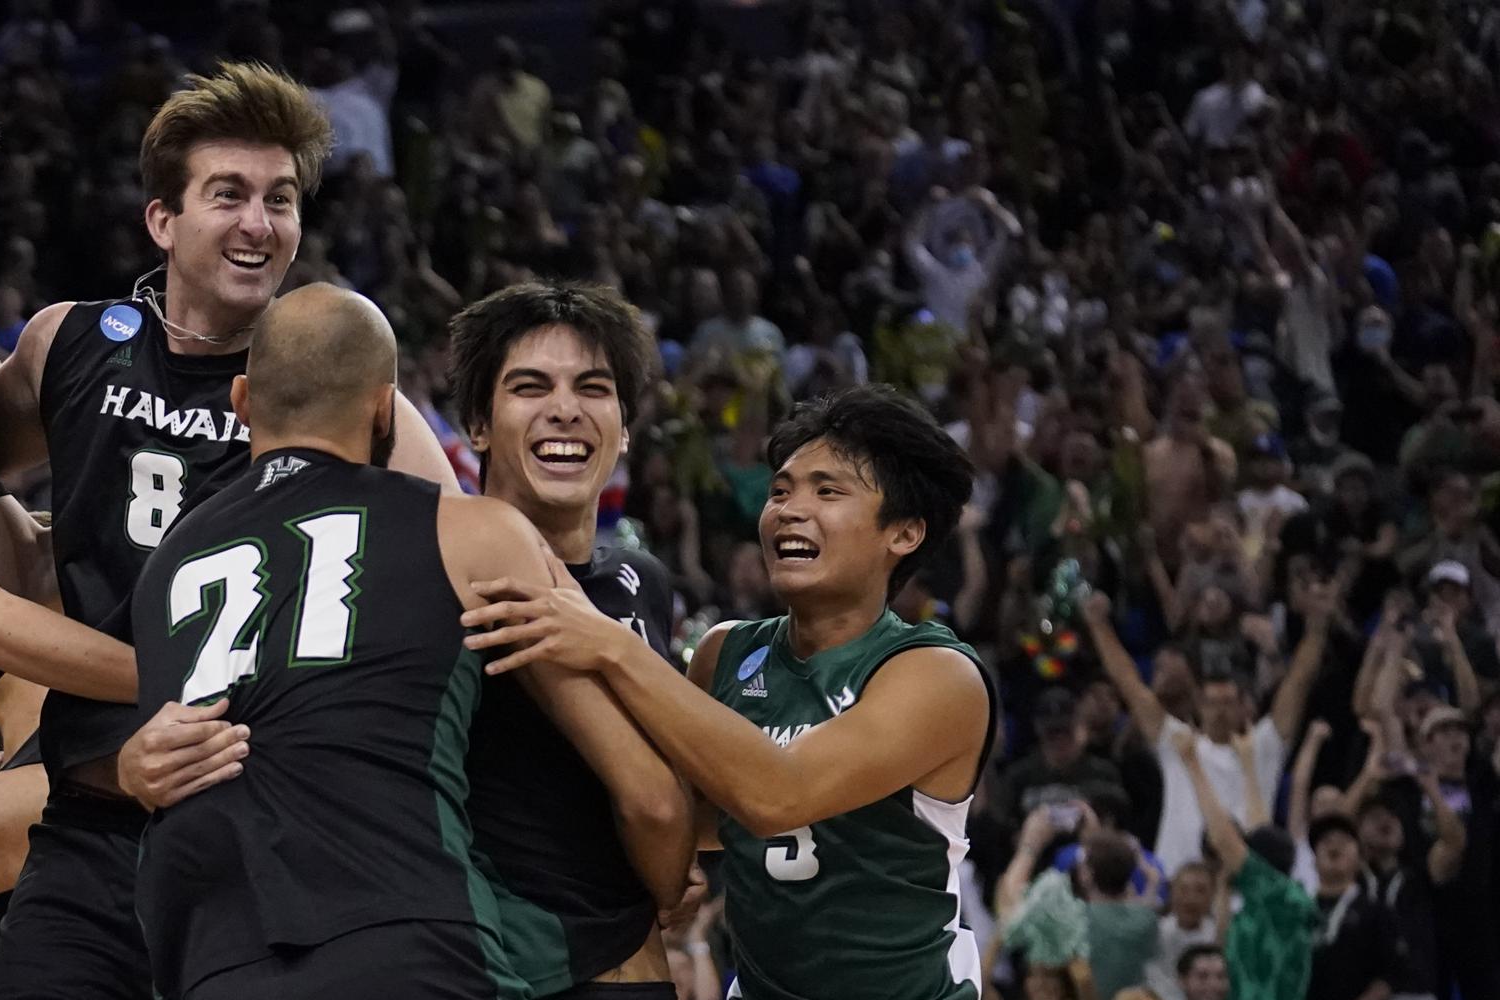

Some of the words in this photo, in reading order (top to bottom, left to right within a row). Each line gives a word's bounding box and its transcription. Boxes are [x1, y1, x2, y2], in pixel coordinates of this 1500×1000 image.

[104, 315, 136, 338] NCAA
[125, 450, 186, 549] 8
[169, 508, 366, 706] 21
